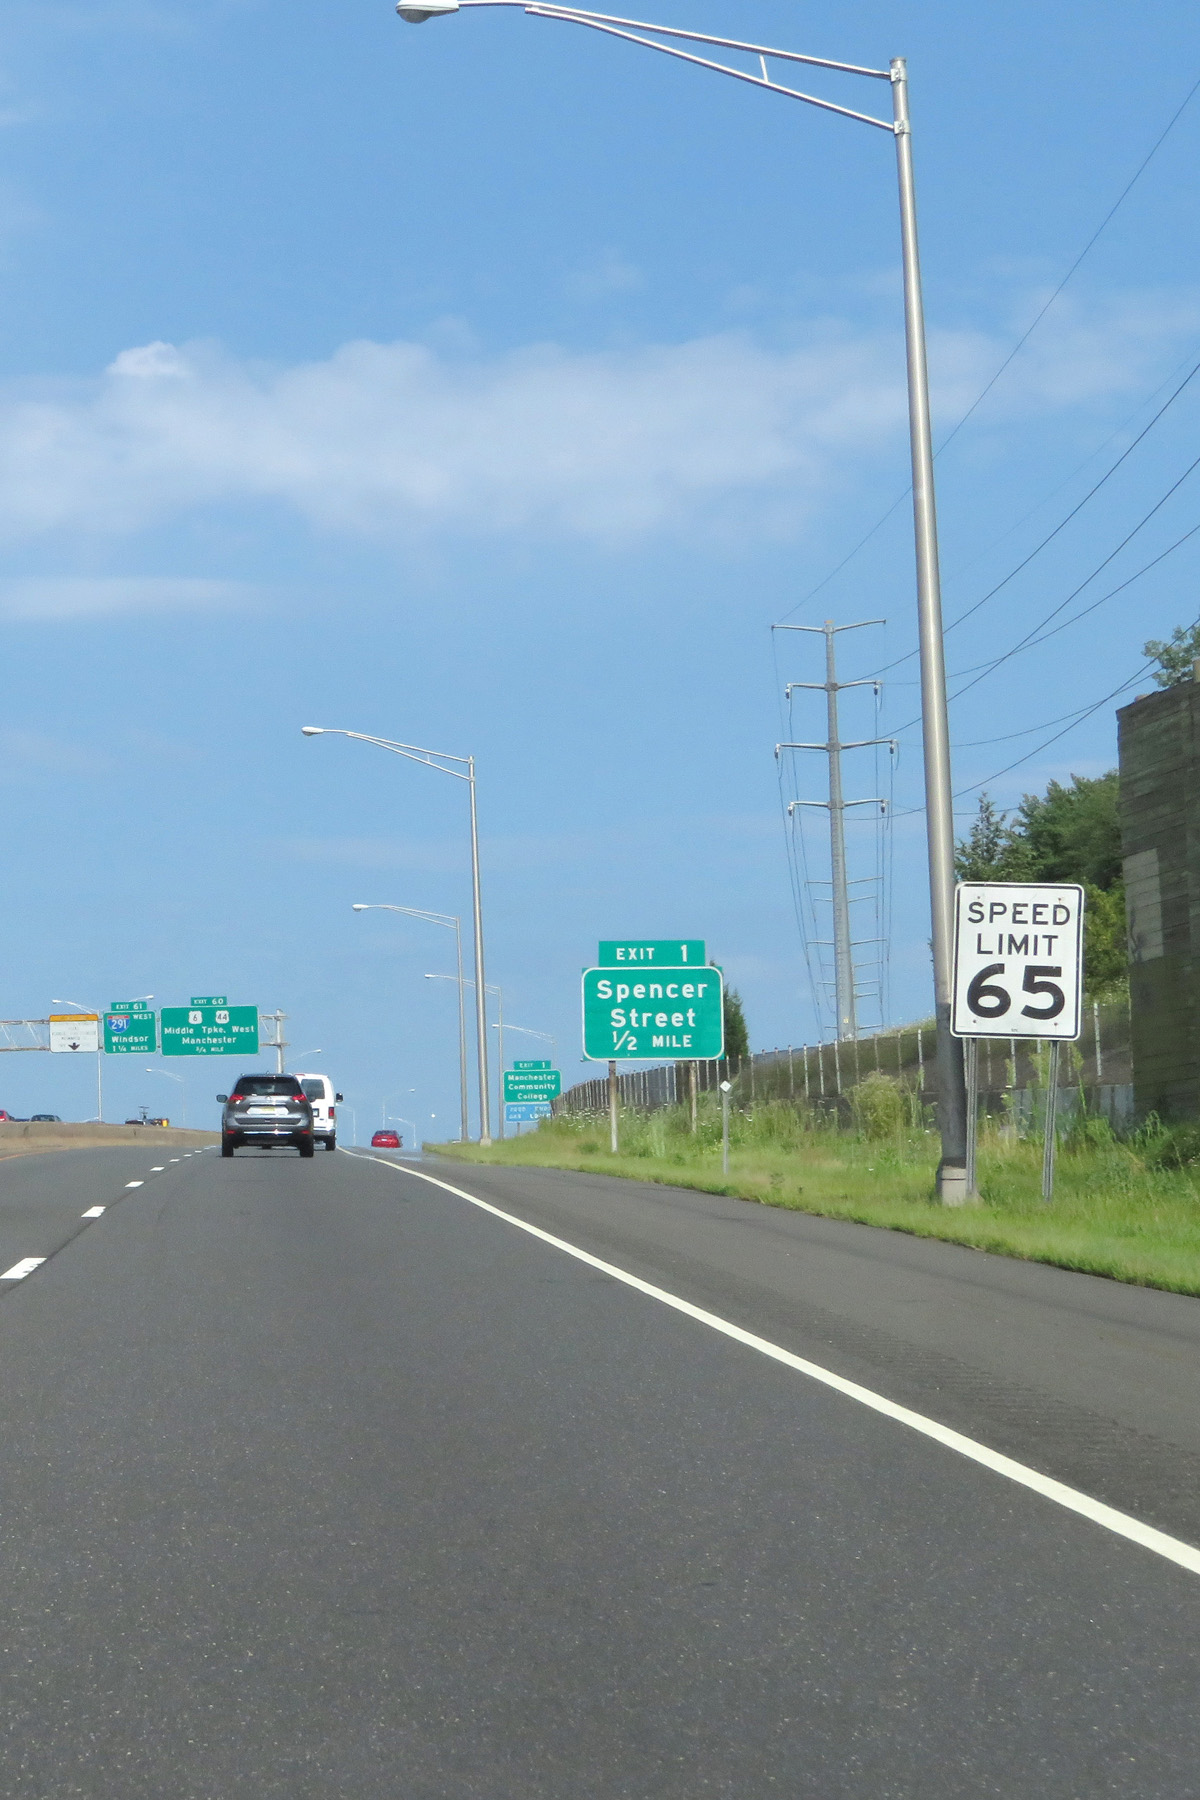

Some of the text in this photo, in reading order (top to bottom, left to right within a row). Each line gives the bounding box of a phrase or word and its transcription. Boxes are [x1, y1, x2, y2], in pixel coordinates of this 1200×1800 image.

[967, 901, 1071, 926] SPEED
[976, 933, 1059, 956] LIMIT
[616, 944, 688, 962] EXIT 1
[596, 979, 708, 1003] Spencer
[966, 963, 1066, 1020] 65
[111, 1019, 127, 1030] 291
[192, 1013, 228, 1022] 6 44
[610, 1008, 696, 1028] Street
[164, 1025, 255, 1034] Middle Tpke. West
[182, 1036, 237, 1045] Manchester
[652, 1035, 693, 1048] MILE
[517, 1092, 548, 1100] College
